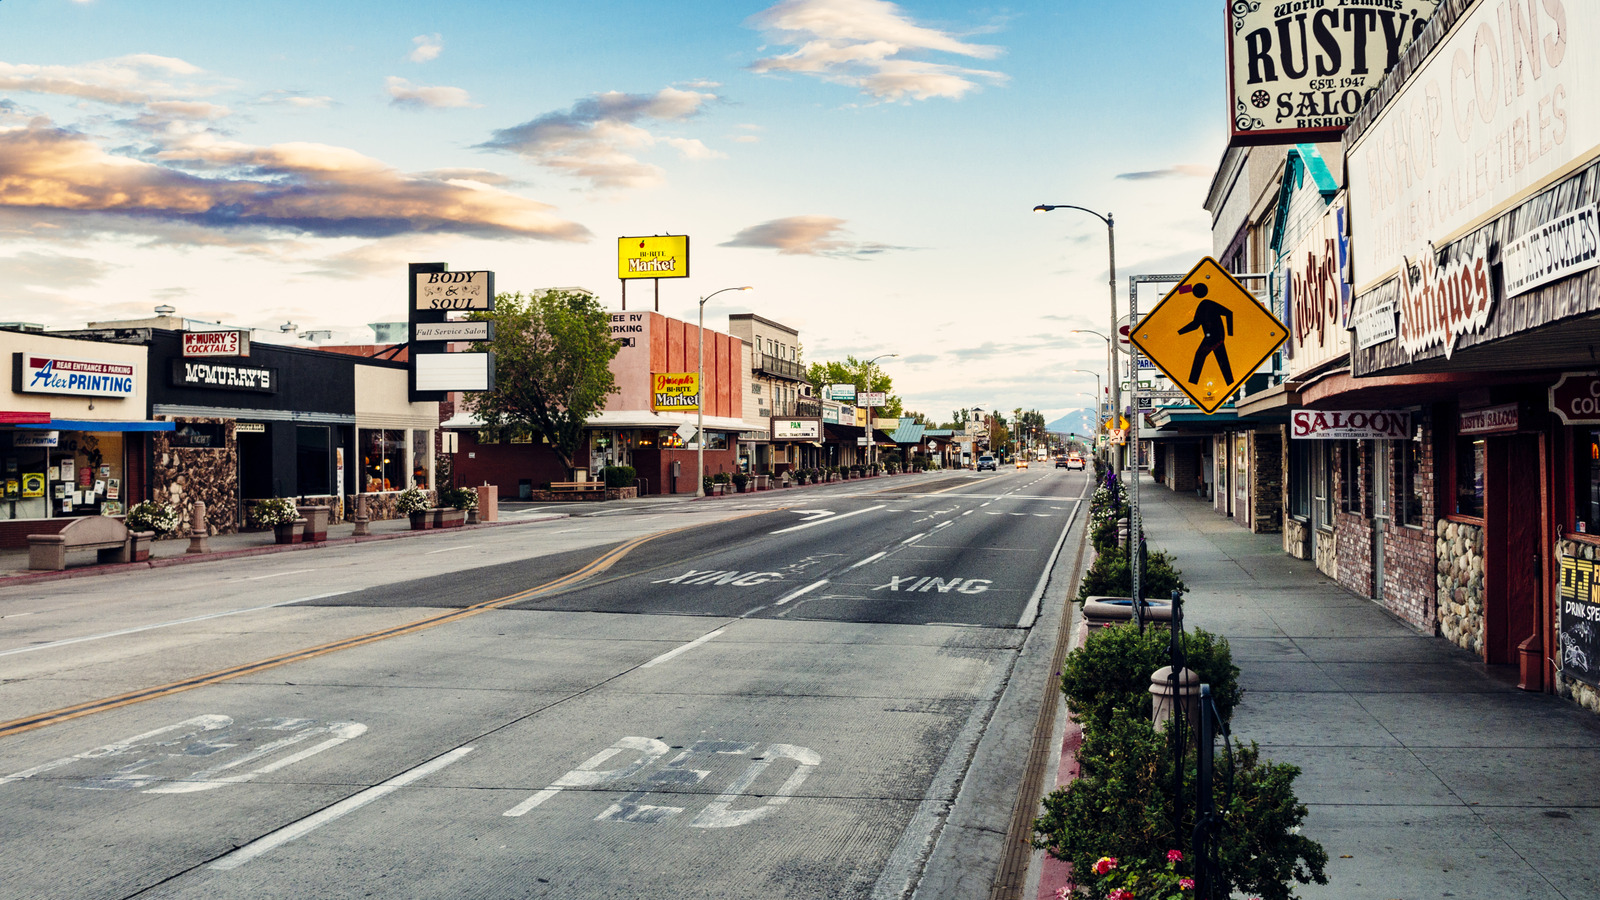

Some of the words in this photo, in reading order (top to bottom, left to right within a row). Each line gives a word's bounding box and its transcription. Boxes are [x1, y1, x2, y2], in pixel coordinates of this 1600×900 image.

[1310, 79, 1337, 91] EST.
[1340, 77, 1366, 87] 1947
[1275, 89, 1380, 123] SALO
[1366, 78, 1442, 219] BISHOP
[1451, 0, 1567, 143] COINS
[1438, 83, 1567, 223] COLLECTIBLES
[1543, 209, 1597, 274] BUCKLES
[628, 256, 676, 272] Market
[427, 272, 477, 284] BODY
[445, 286, 458, 296] &
[429, 299, 476, 310] SOUL
[1401, 253, 1488, 347] Antiques
[629, 314, 643, 322] RV
[416, 328, 433, 336] Full
[434, 327, 462, 336] Service
[464, 327, 486, 335] Salon
[186, 344, 237, 353] COCKTAILS
[30, 360, 67, 388] Alex
[68, 373, 132, 392] PRINTING
[56, 361, 72, 369] REAR
[73, 363, 102, 372] ENTRANCE
[108, 366, 131, 374] PARKING
[655, 392, 700, 406] Market
[1294, 412, 1409, 437] SALOON
[1487, 410, 1518, 426] SALOON
[651, 569, 784, 587] XING
[872, 576, 993, 595] XING
[1561, 556, 1593, 601] DJ
[1565, 601, 1586, 618] DRINK
[503, 736, 822, 829] PED
